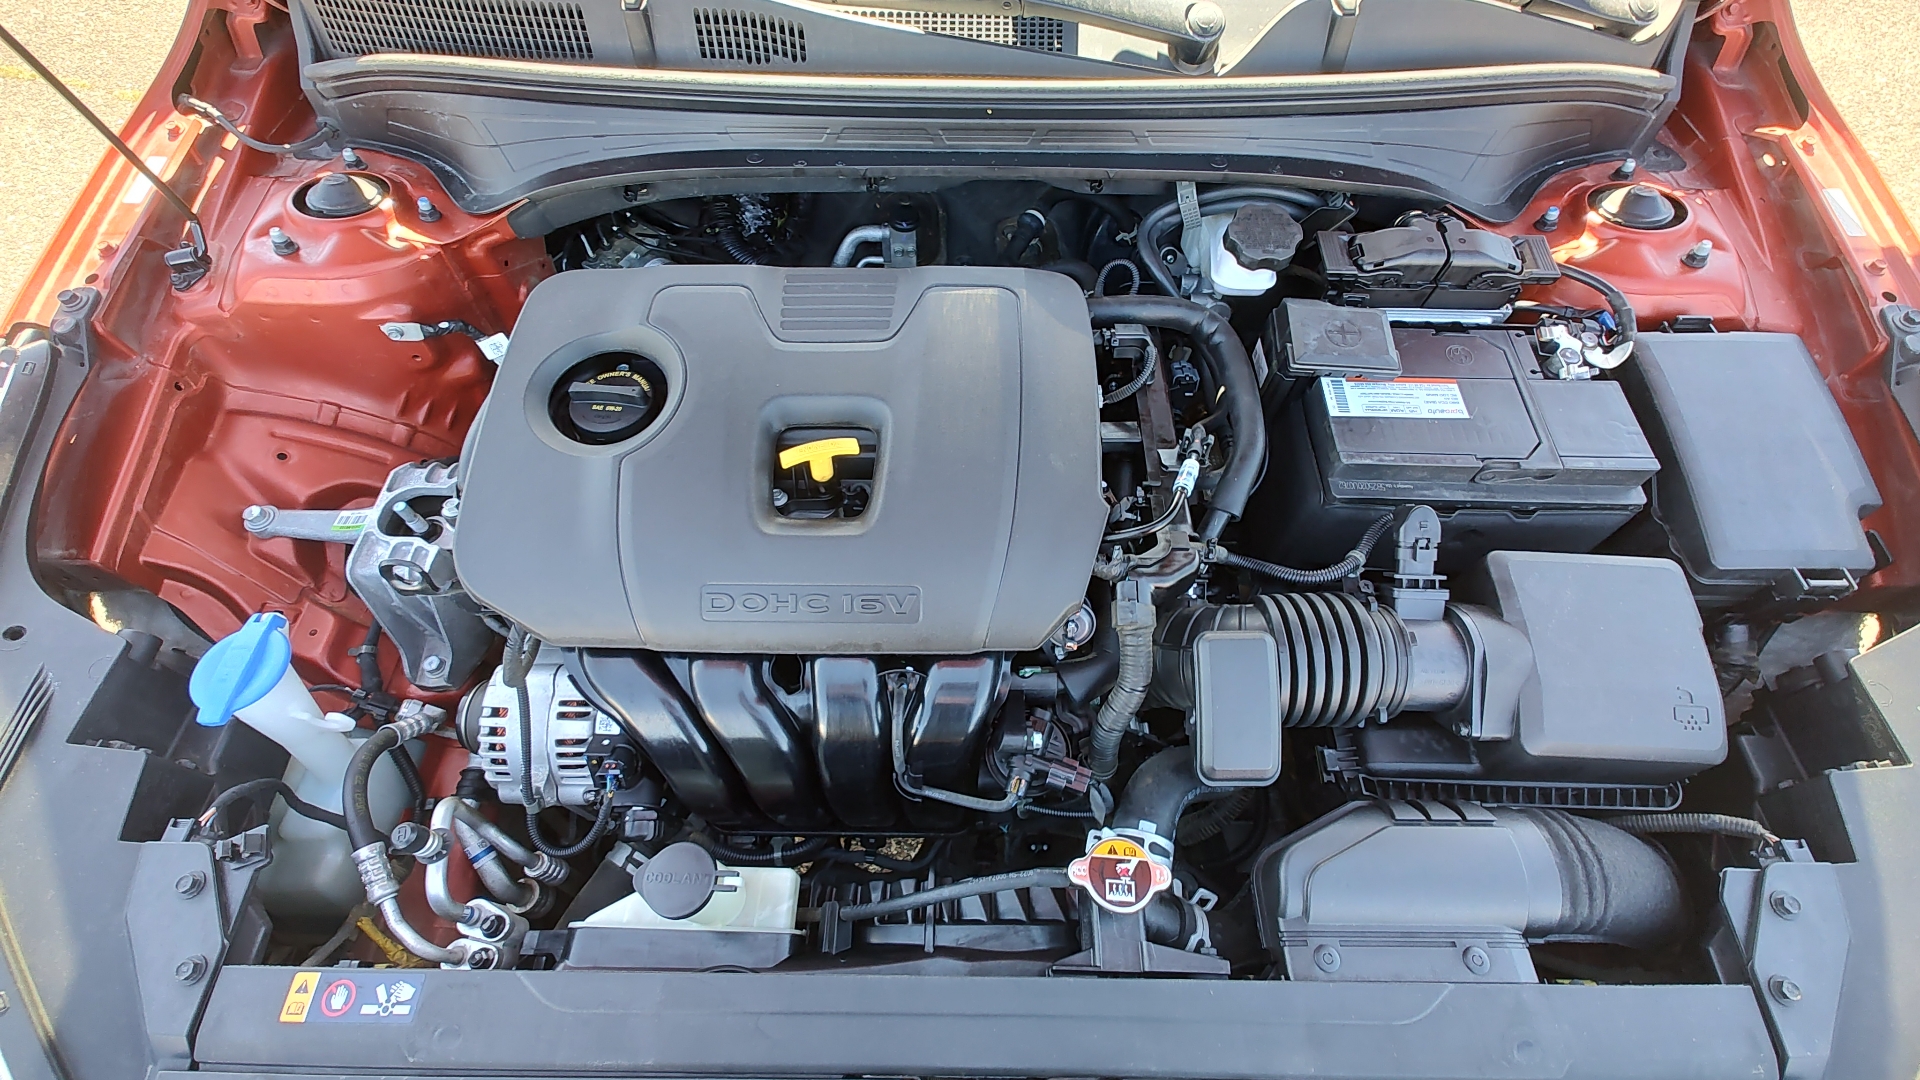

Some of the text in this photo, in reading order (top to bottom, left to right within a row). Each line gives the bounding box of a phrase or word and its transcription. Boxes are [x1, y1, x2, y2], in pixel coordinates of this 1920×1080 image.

[597, 371, 632, 381] OWNER'S
[706, 591, 917, 615] DOHC 16V
[646, 871, 711, 885] COOLANT
